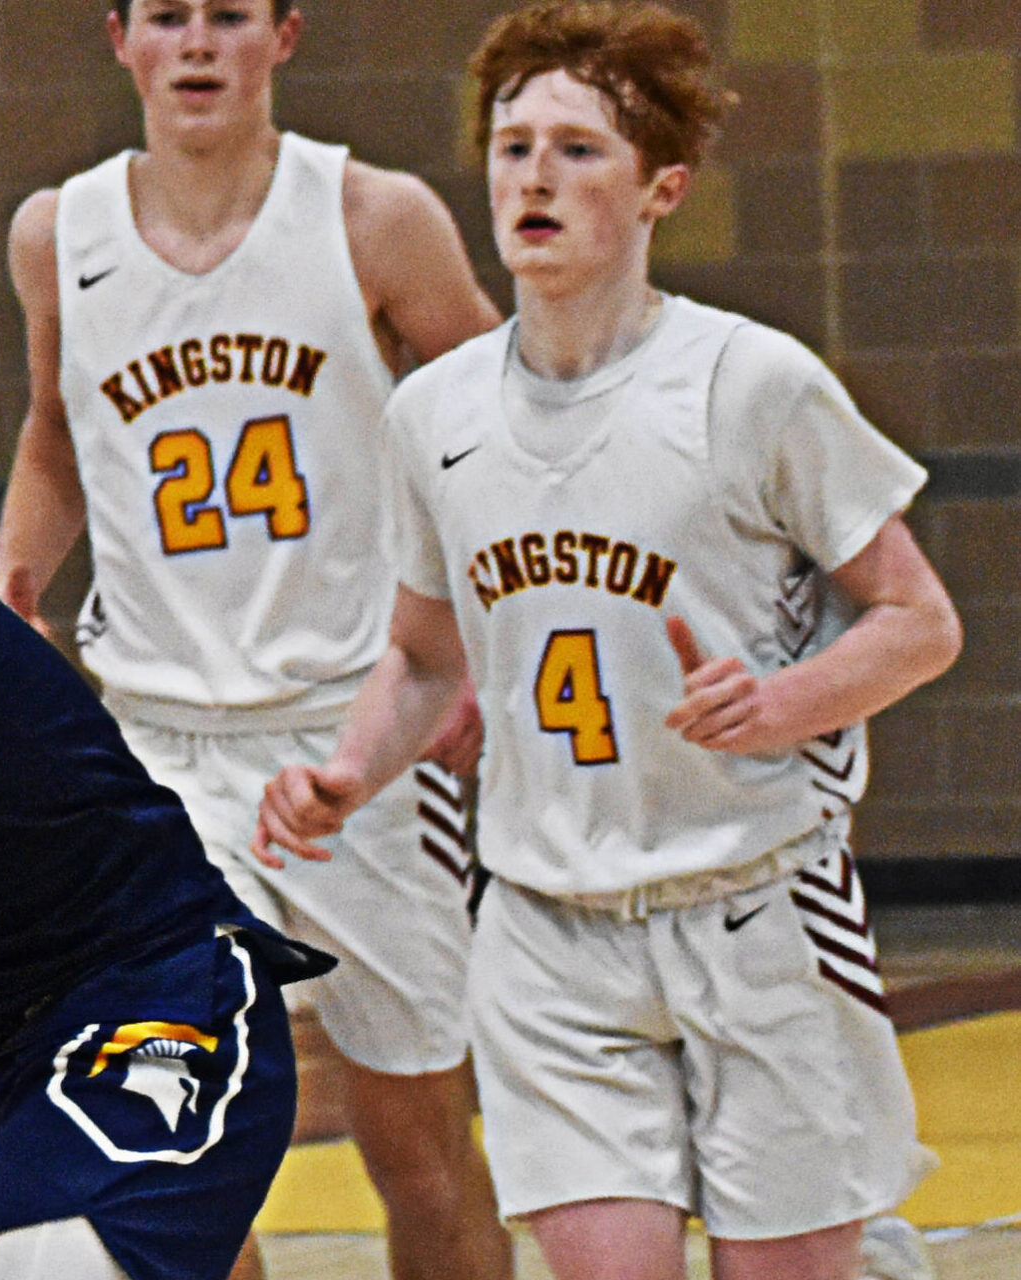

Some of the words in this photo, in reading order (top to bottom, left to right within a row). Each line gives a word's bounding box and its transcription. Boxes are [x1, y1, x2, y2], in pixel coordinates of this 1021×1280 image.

[100, 333, 327, 425] KINGSTON
[148, 413, 310, 557] 24
[534, 627, 620, 766] 4
